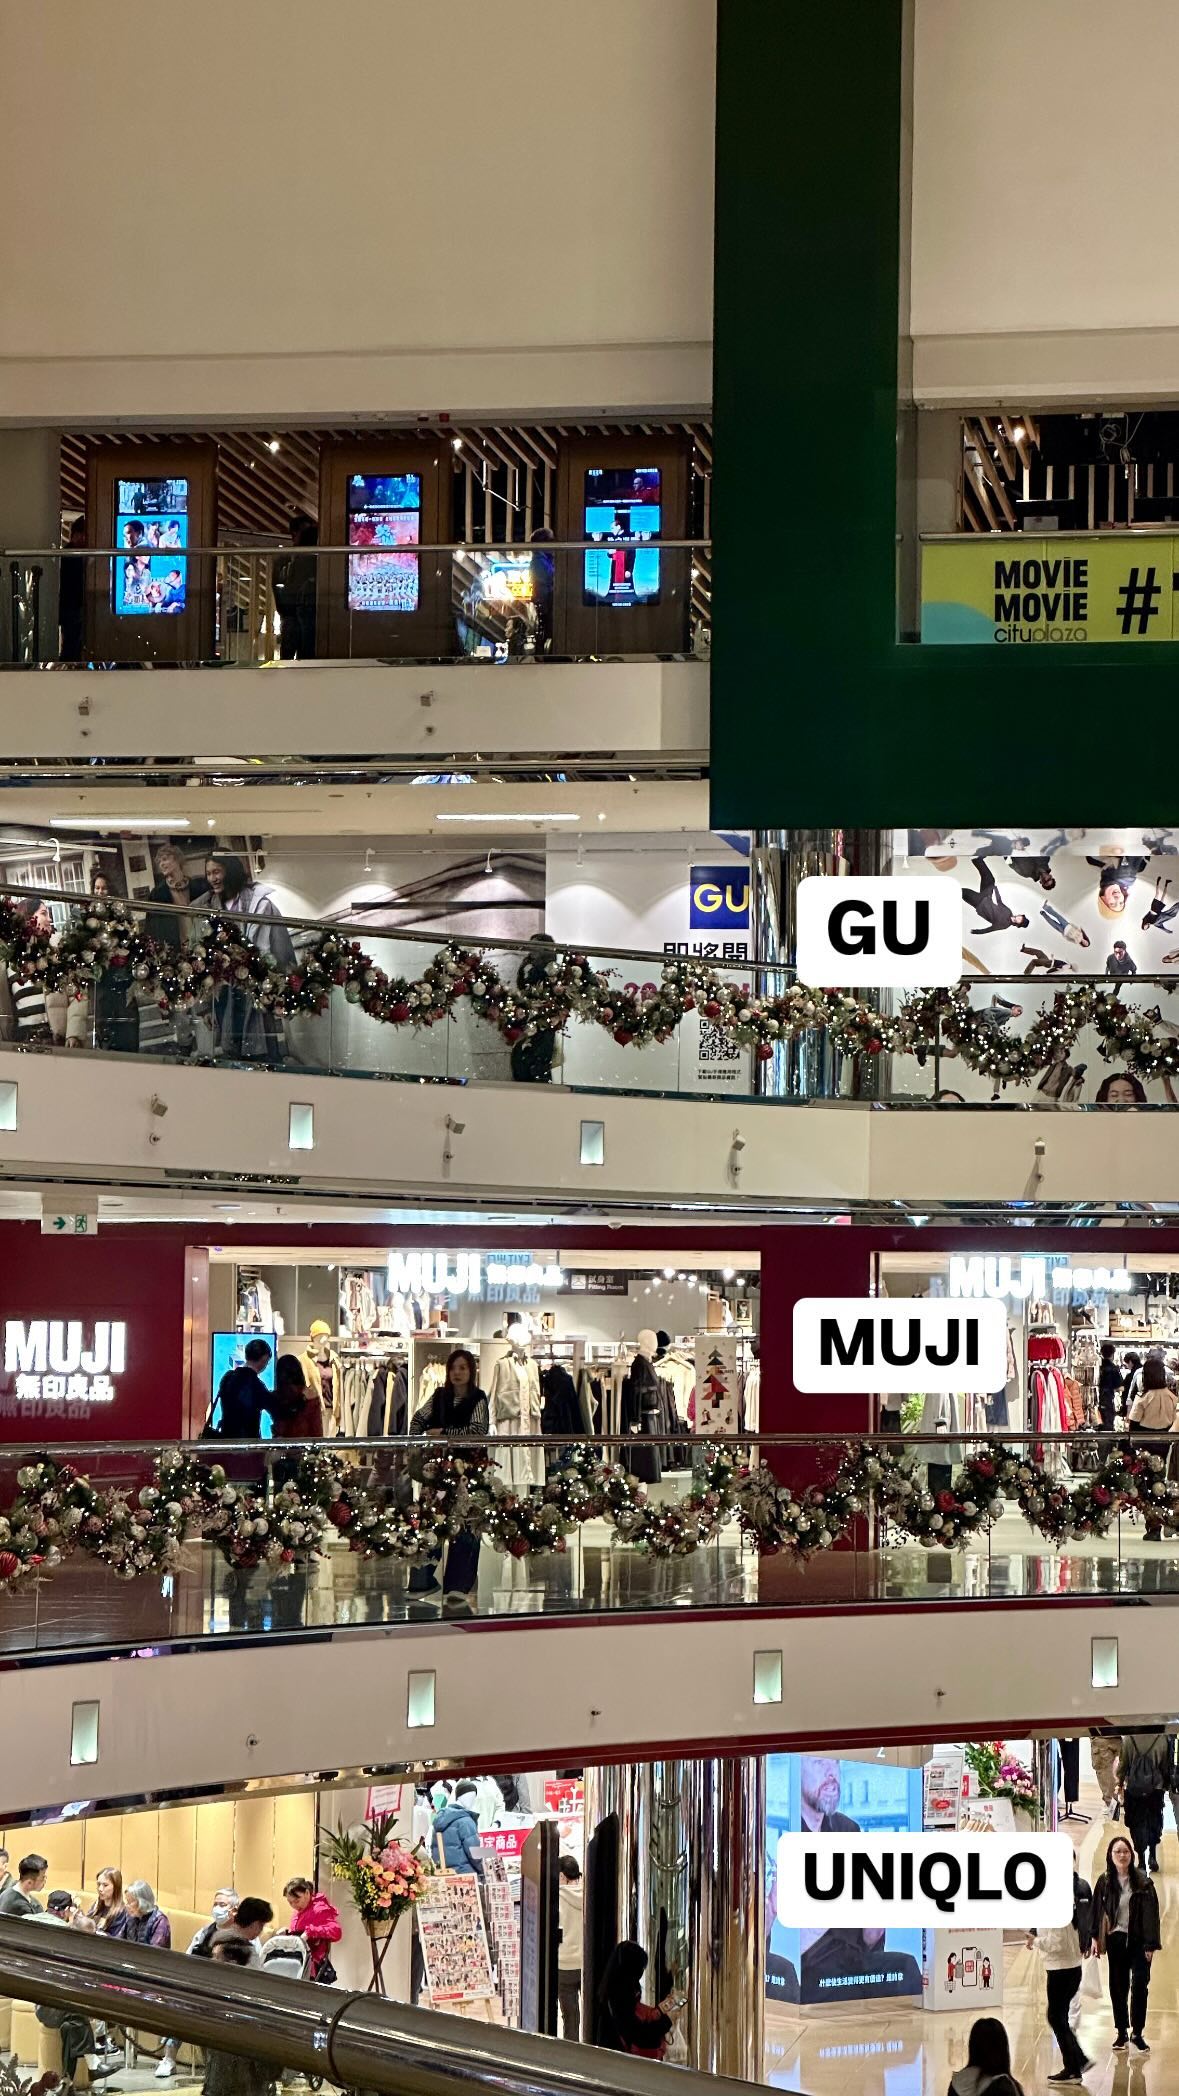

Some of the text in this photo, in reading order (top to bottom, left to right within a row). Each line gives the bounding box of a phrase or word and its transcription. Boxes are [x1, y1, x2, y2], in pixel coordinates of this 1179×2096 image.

[994, 556, 1089, 590] MOVIE
[994, 590, 1088, 622] MOVIE
[994, 624, 1088, 643] cityplaza
[693, 882, 750, 913] GU
[387, 1252, 481, 1294] MUJI
[949, 1256, 1046, 1298] MUJI
[4, 1320, 126, 1374] MUJI
